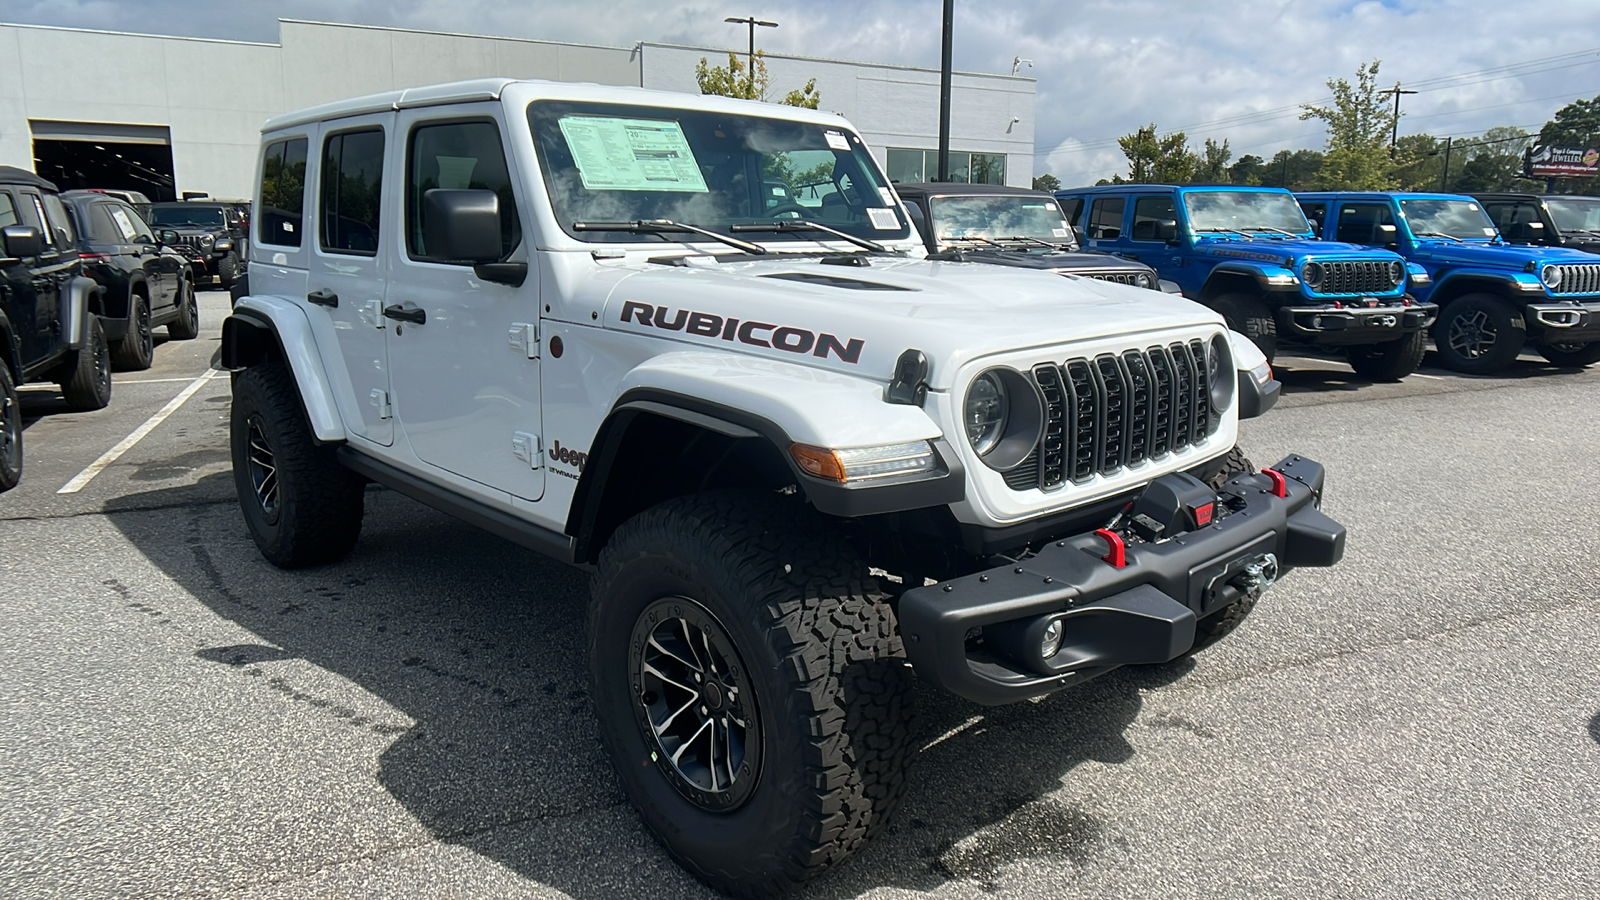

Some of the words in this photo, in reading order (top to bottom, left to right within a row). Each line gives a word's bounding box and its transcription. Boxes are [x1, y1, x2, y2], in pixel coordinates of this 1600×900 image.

[1552, 155, 1582, 163] JEWELERS
[1212, 249, 1280, 261] RUBICON
[620, 300, 865, 364] RUBICON
[549, 440, 588, 472] Jeep
